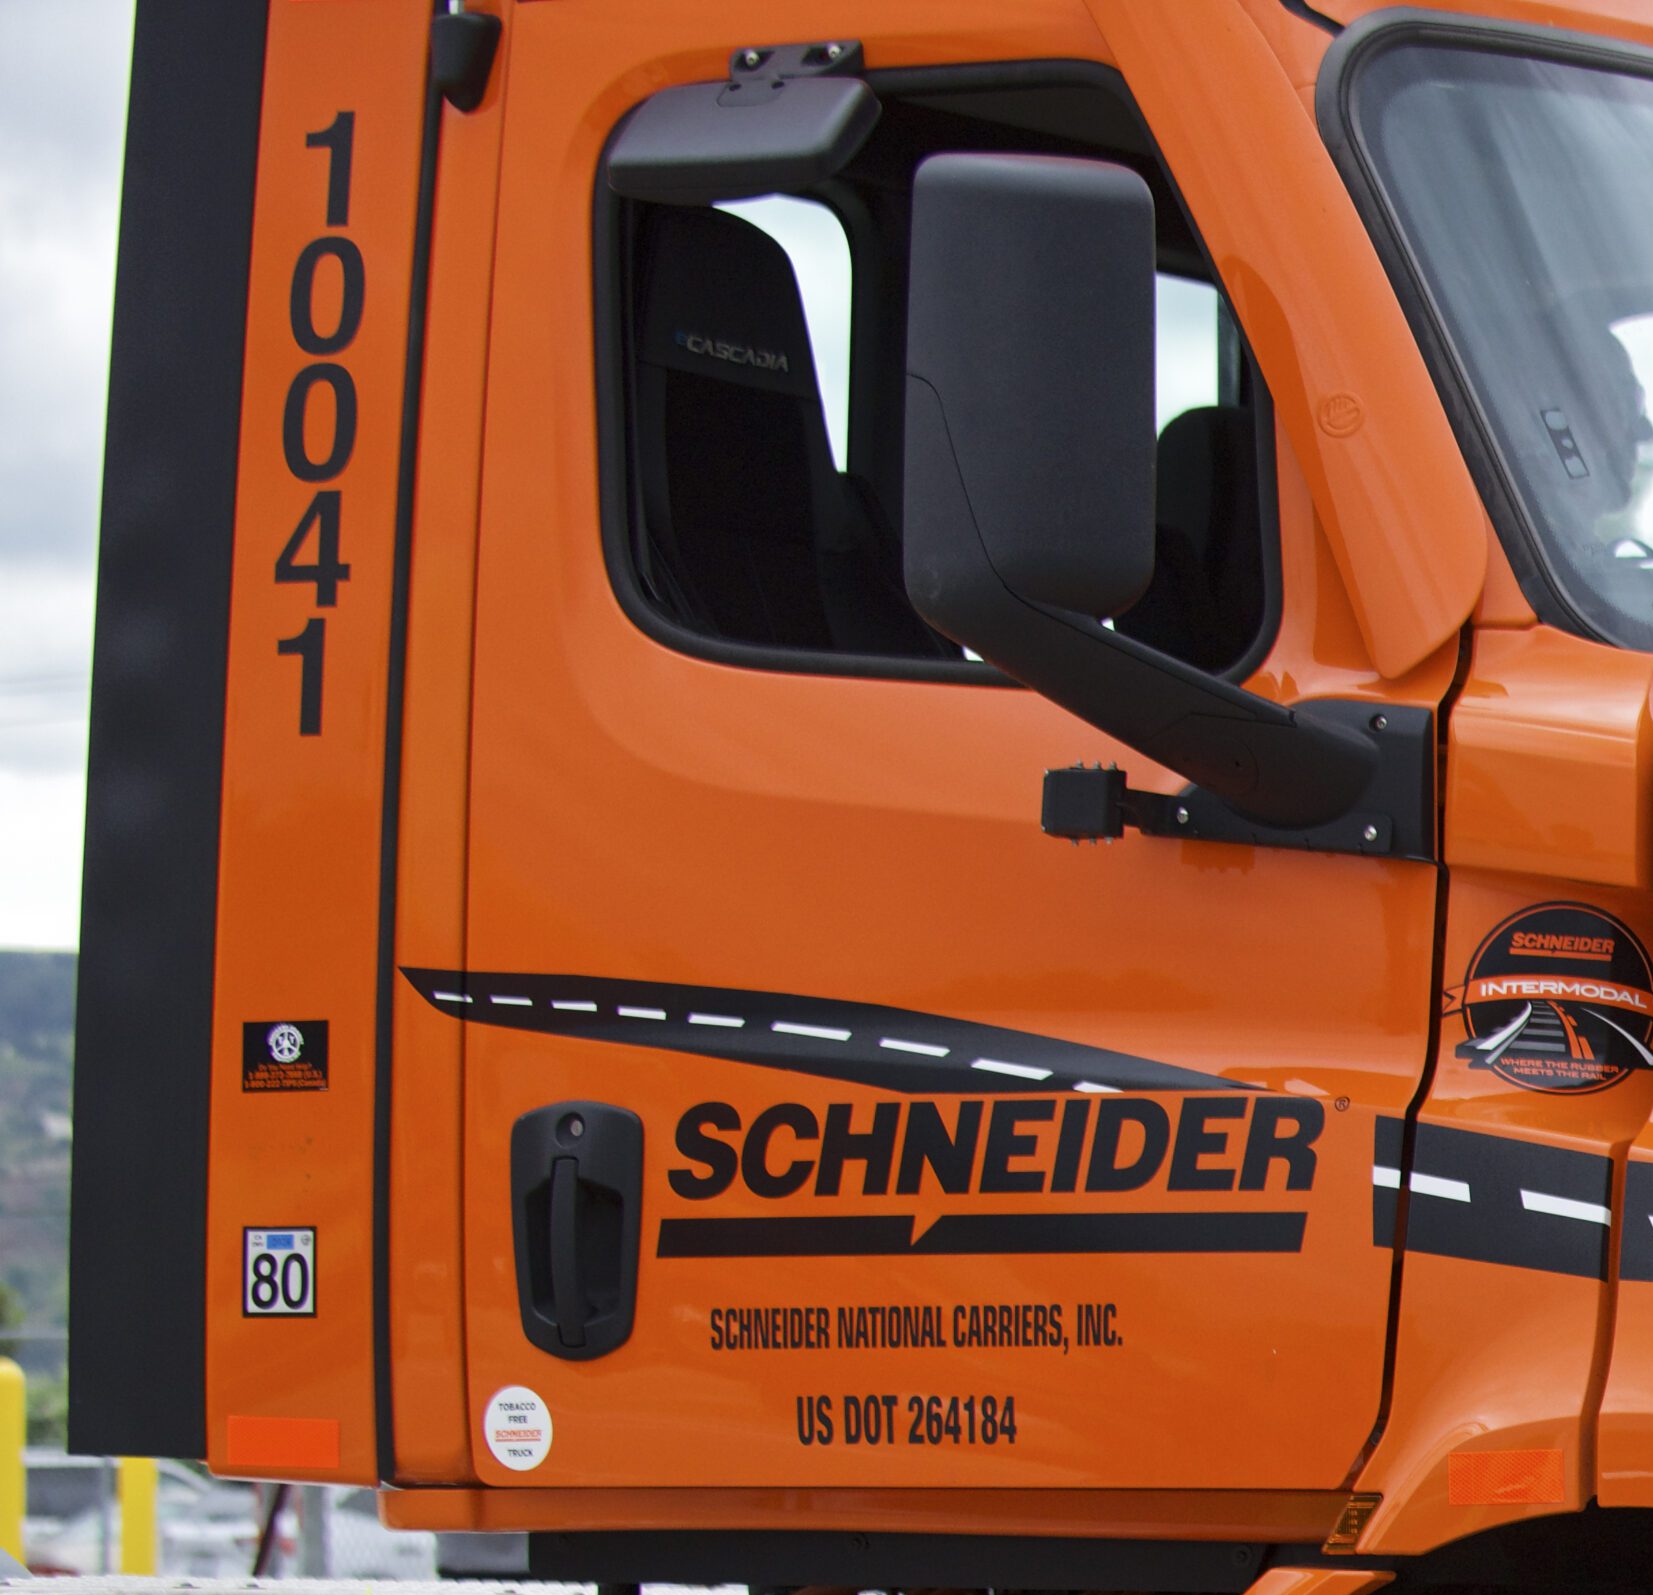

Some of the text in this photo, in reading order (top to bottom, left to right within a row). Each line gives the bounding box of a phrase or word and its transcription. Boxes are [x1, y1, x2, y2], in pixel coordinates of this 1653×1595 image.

[275, 111, 365, 736] 10041
[1511, 931, 1616, 954] SCHNEIDER
[1480, 980, 1648, 1009] INTERMODAL
[1501, 1057, 1619, 1074] WHERE THE RUBBER
[1514, 1067, 1607, 1081] MEETS THE RAIL
[667, 1096, 1326, 1199] SCHNEIDER
[252, 1253, 309, 1310] 80
[710, 1303, 1123, 1355] SCHNEIDER NATIONAL CARRIERS, INC.
[498, 1402, 537, 1412] TOBACCO
[508, 1415, 528, 1424] FREE
[796, 1394, 1017, 1446] US DOT 264184
[507, 1448, 534, 1458] TRUCK
